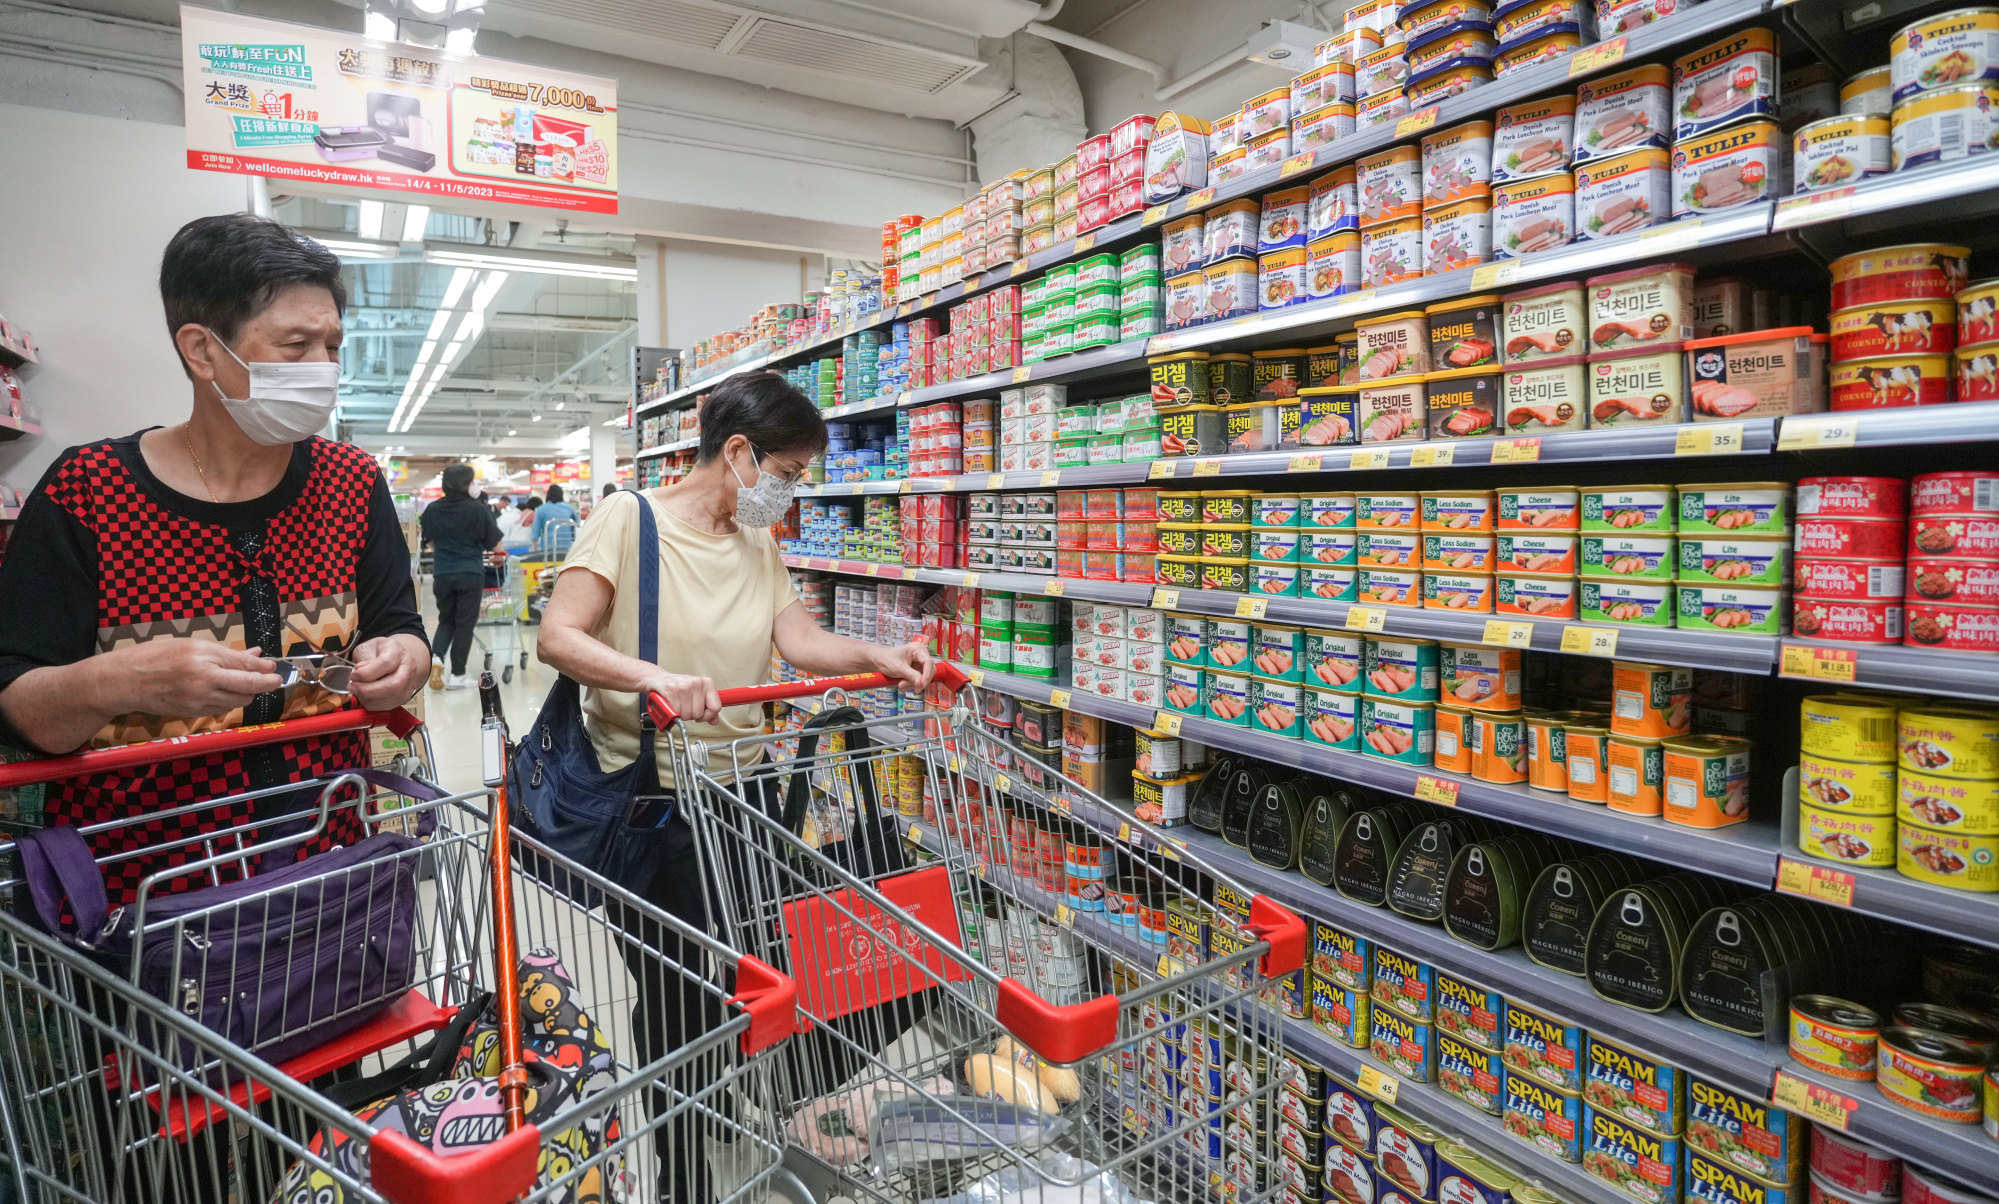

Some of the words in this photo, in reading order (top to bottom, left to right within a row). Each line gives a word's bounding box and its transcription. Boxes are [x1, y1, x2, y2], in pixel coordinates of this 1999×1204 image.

[1926, 22, 1977, 39] TULIP
[1937, 34, 1966, 46] Cocktail
[1686, 38, 1748, 72] TULIP
[1302, 72, 1321, 84] TULIP
[1680, 83, 1694, 92] Pork
[1695, 73, 1724, 88] Luncheon
[206, 81, 250, 102] 大獎
[528, 83, 586, 109] 7,000
[1596, 80, 1633, 96] TULIP
[206, 99, 229, 107] Grand
[230, 102, 250, 110] Prize
[1604, 95, 1624, 106] Danish
[1516, 108, 1552, 122] TULIP
[1518, 128, 1544, 139] Luncheon
[1522, 122, 1542, 132] Danish
[1435, 136, 1462, 149] TULIP
[1811, 129, 1852, 144] TULIP
[1690, 132, 1756, 158] TULIP
[1819, 140, 1844, 150] Cocktail
[246, 161, 373, 183] wellcomeluckydraw.hk
[576, 164, 606, 176] HK$20
[1367, 158, 1392, 171] TULIP
[1682, 170, 1697, 179] Pork
[1700, 162, 1729, 176] Luncheon
[1730, 157, 1748, 166] Meat
[406, 178, 431, 191] 14/4
[440, 182, 493, 198] 11/5/2023
[1602, 180, 1622, 190] Danish
[1512, 188, 1546, 200] TULIP
[1520, 202, 1539, 210] Danish
[1434, 211, 1460, 224] TULIP
[1168, 226, 1185, 236] TULIP
[1373, 228, 1398, 240] TULIP
[1315, 247, 1334, 257] TULIP
[1267, 260, 1286, 270] TULIP
[1210, 271, 1228, 281] TULIP
[1904, 279, 1945, 288] CORNED
[1172, 282, 1190, 290] TULIP
[1595, 292, 1664, 318] 런천미트
[1508, 308, 1566, 334] 런천미트
[1367, 328, 1407, 346] 런천미트
[1432, 322, 1474, 342] 런천미트
[1847, 338, 1884, 349] CORNED
[1729, 354, 1786, 374] 런천미트
[1152, 364, 1186, 384] 리챔
[1596, 372, 1664, 394] 런천미트
[1430, 392, 1474, 409] 런천미트
[1509, 382, 1568, 403] 런천미트
[1310, 400, 1352, 416] 런천미트
[1371, 394, 1412, 410] 런천미트
[1164, 414, 1194, 434] 리챔
[1714, 436, 1736, 446] 35.0
[1162, 500, 1185, 515] 리챔
[1206, 499, 1232, 516] 리챔
[1528, 496, 1552, 504] Cheese
[1162, 533, 1185, 548] 리챔
[1206, 534, 1232, 550] 리챔
[1384, 538, 1402, 546] Sodium
[1523, 540, 1546, 548] Cheese
[1722, 546, 1738, 554] Lite
[1162, 563, 1185, 580] 리챔
[1206, 566, 1232, 583] 리챔
[1371, 574, 1382, 582] Less
[1525, 583, 1546, 591] Cheese
[1722, 594, 1738, 602] Lite
[1176, 624, 1190, 632] Original
[1220, 628, 1236, 636] Original
[1822, 620, 1874, 632] 辣味肉醬
[1264, 635, 1282, 644] Original
[1325, 642, 1346, 652] Original
[1380, 648, 1403, 658] Original
[1464, 652, 1478, 660] Less
[1460, 658, 1482, 666] Sodium
[1173, 672, 1188, 680] Original
[1218, 680, 1234, 690] Original
[1377, 709, 1400, 720] Original
[1340, 876, 1360, 886] MAGRO
[1820, 869, 1846, 884] 特價
[1820, 880, 1848, 894] $28/2
[1168, 912, 1198, 936] SPAM
[1316, 926, 1354, 954] SPAM
[1316, 939, 1342, 960] Lite
[1376, 950, 1418, 980] SPAM
[1376, 966, 1404, 986] Lite
[1594, 971, 1625, 984] MAGRO
[1628, 978, 1664, 996] IBÉRICO
[1438, 976, 1486, 1011] SPAM
[1690, 992, 1722, 1005] MAGRO
[1373, 1008, 1414, 1042] SPAM
[1508, 1008, 1564, 1046] SPAM
[1507, 1027, 1545, 1052] Lite
[1814, 1027, 1852, 1047] 五香肉丁
[1440, 1038, 1488, 1072] SPAM
[1440, 1052, 1473, 1076] Lite
[1590, 1044, 1655, 1085] SPAM
[1894, 1058, 1936, 1082] 五香肉丁
[1590, 1062, 1633, 1090] Lite
[1507, 1076, 1564, 1116] SPAM
[1330, 1100, 1352, 1118] Luncheon
[1352, 1117, 1366, 1128] Meat
[1507, 1096, 1544, 1120] Lite
[1692, 1082, 1767, 1130] SPAM
[1692, 1103, 1740, 1132] Lite
[1593, 1116, 1660, 1162] SPAM
[1379, 1138, 1405, 1160] Luncheon
[1406, 1155, 1422, 1170] Meat
[1592, 1135, 1636, 1164] Lite
[1328, 1154, 1352, 1174] Luncheon
[1353, 1172, 1368, 1186] Meat
[1692, 1158, 1764, 1204] SPAM
[1692, 1180, 1737, 1204] Lite
